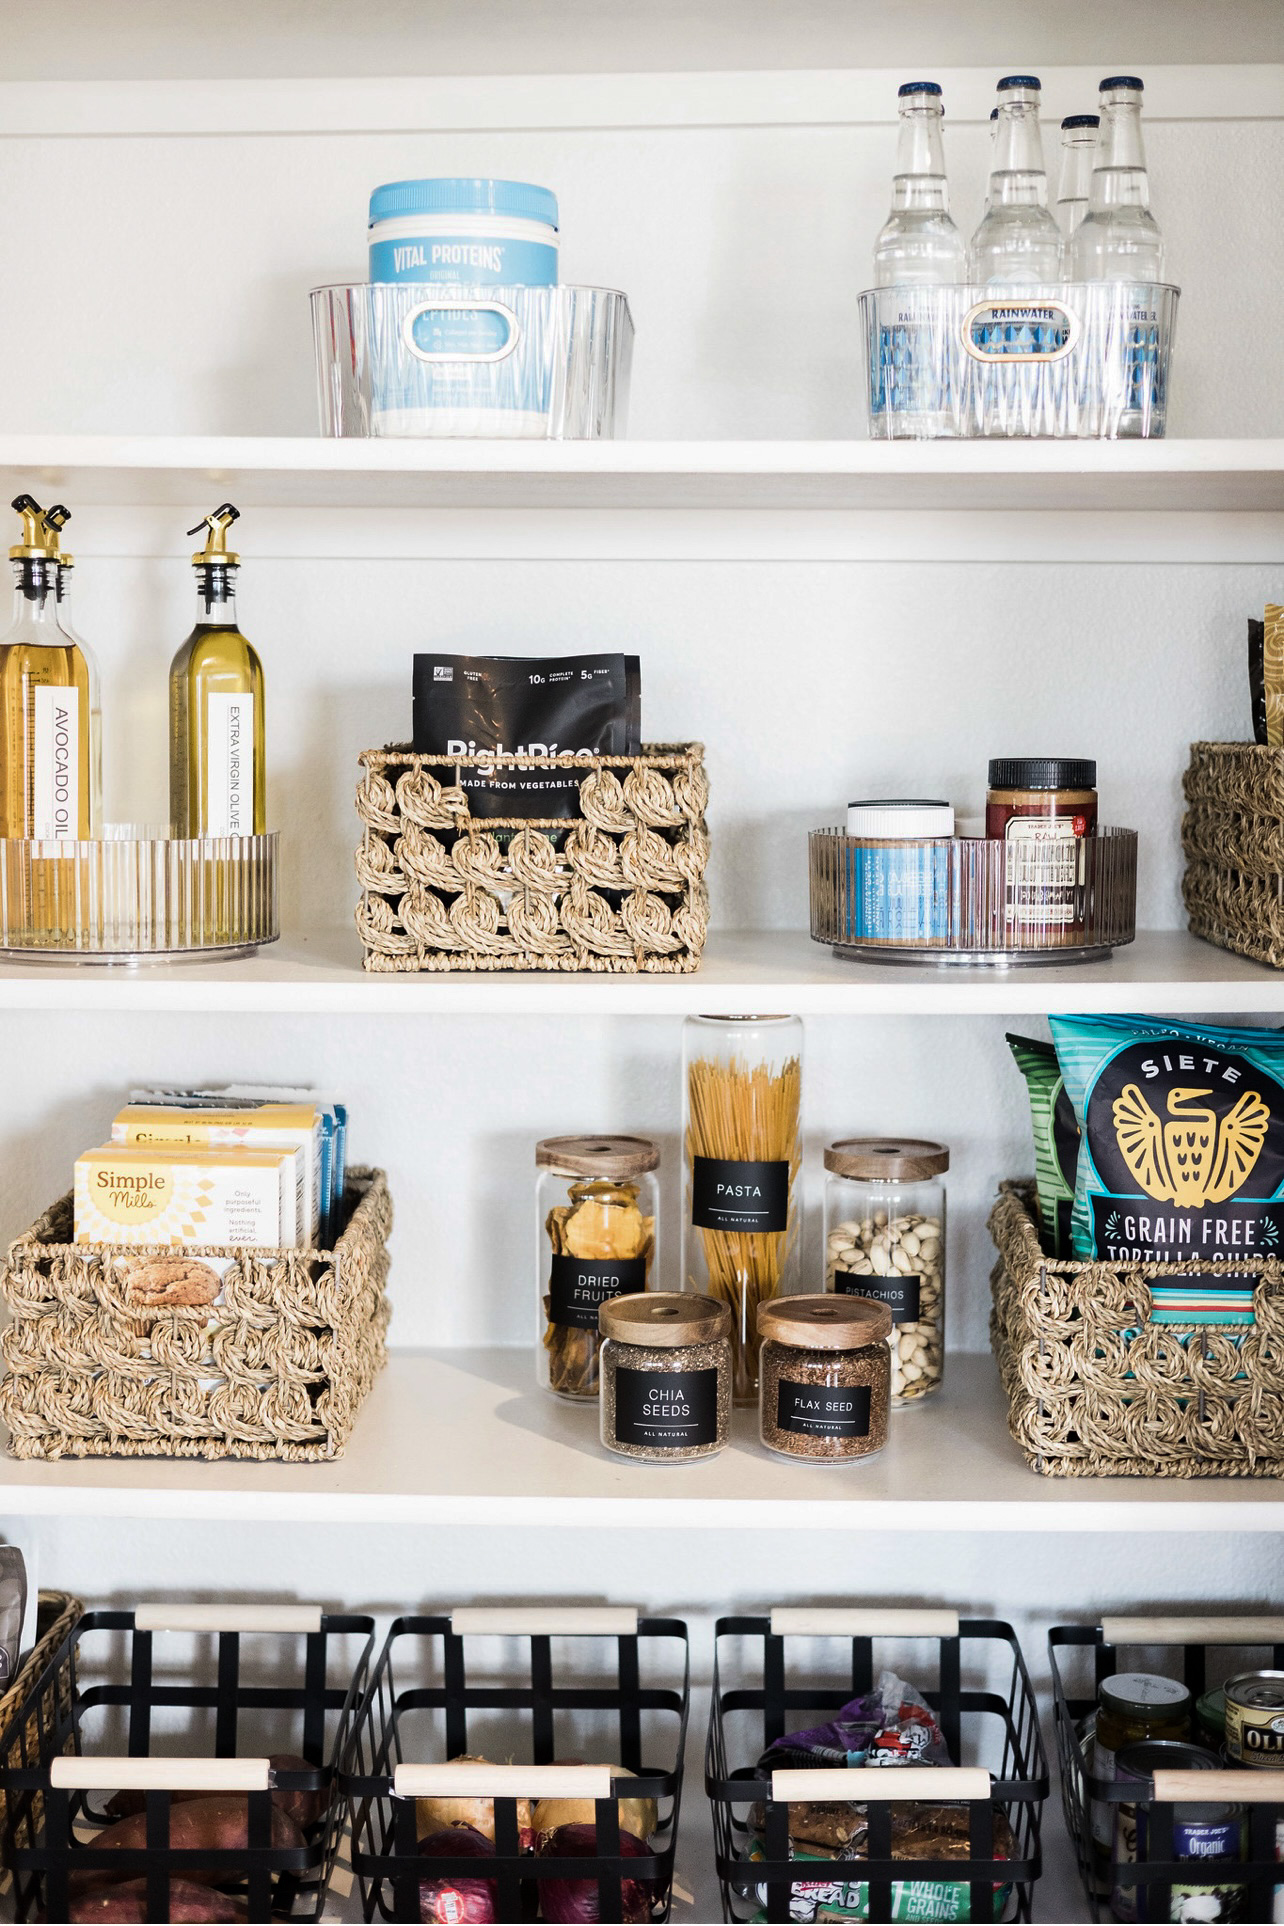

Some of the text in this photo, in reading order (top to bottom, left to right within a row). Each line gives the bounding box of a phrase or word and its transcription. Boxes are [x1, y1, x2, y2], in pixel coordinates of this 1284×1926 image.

[394, 244, 503, 274] VITAL PROTEINS
[429, 270, 460, 280] ORIGINAL
[992, 309, 1055, 320] RAINWATER
[528, 674, 546, 685] 10G
[581, 670, 593, 680] 5G
[230, 706, 240, 747] EXTRA
[55, 707, 69, 839] AVOCADO OIL
[230, 748, 240, 791] VIRGIN
[460, 780, 579, 790] MADE FROM VEGETABLES
[230, 793, 240, 829] OLIVE
[1141, 1054, 1242, 1083] SIETE
[97, 1171, 165, 1192] Simple
[234, 1190, 251, 1198] Only
[717, 1184, 762, 1197] PASTA
[109, 1190, 156, 1209] Mills
[229, 1219, 256, 1227] Nothing
[1124, 1216, 1256, 1246] GRAIN FREE
[578, 1274, 620, 1288] DRIED
[845, 1286, 905, 1300] PISTACHIOS
[648, 1388, 685, 1401] CHIA
[642, 1403, 690, 1417] SEEDS
[794, 1398, 853, 1412] FLAX SEED
[1189, 1836, 1226, 1858] Organic
[910, 1881, 962, 1905] WHOLE
[907, 1896, 959, 1921] GRAINS
